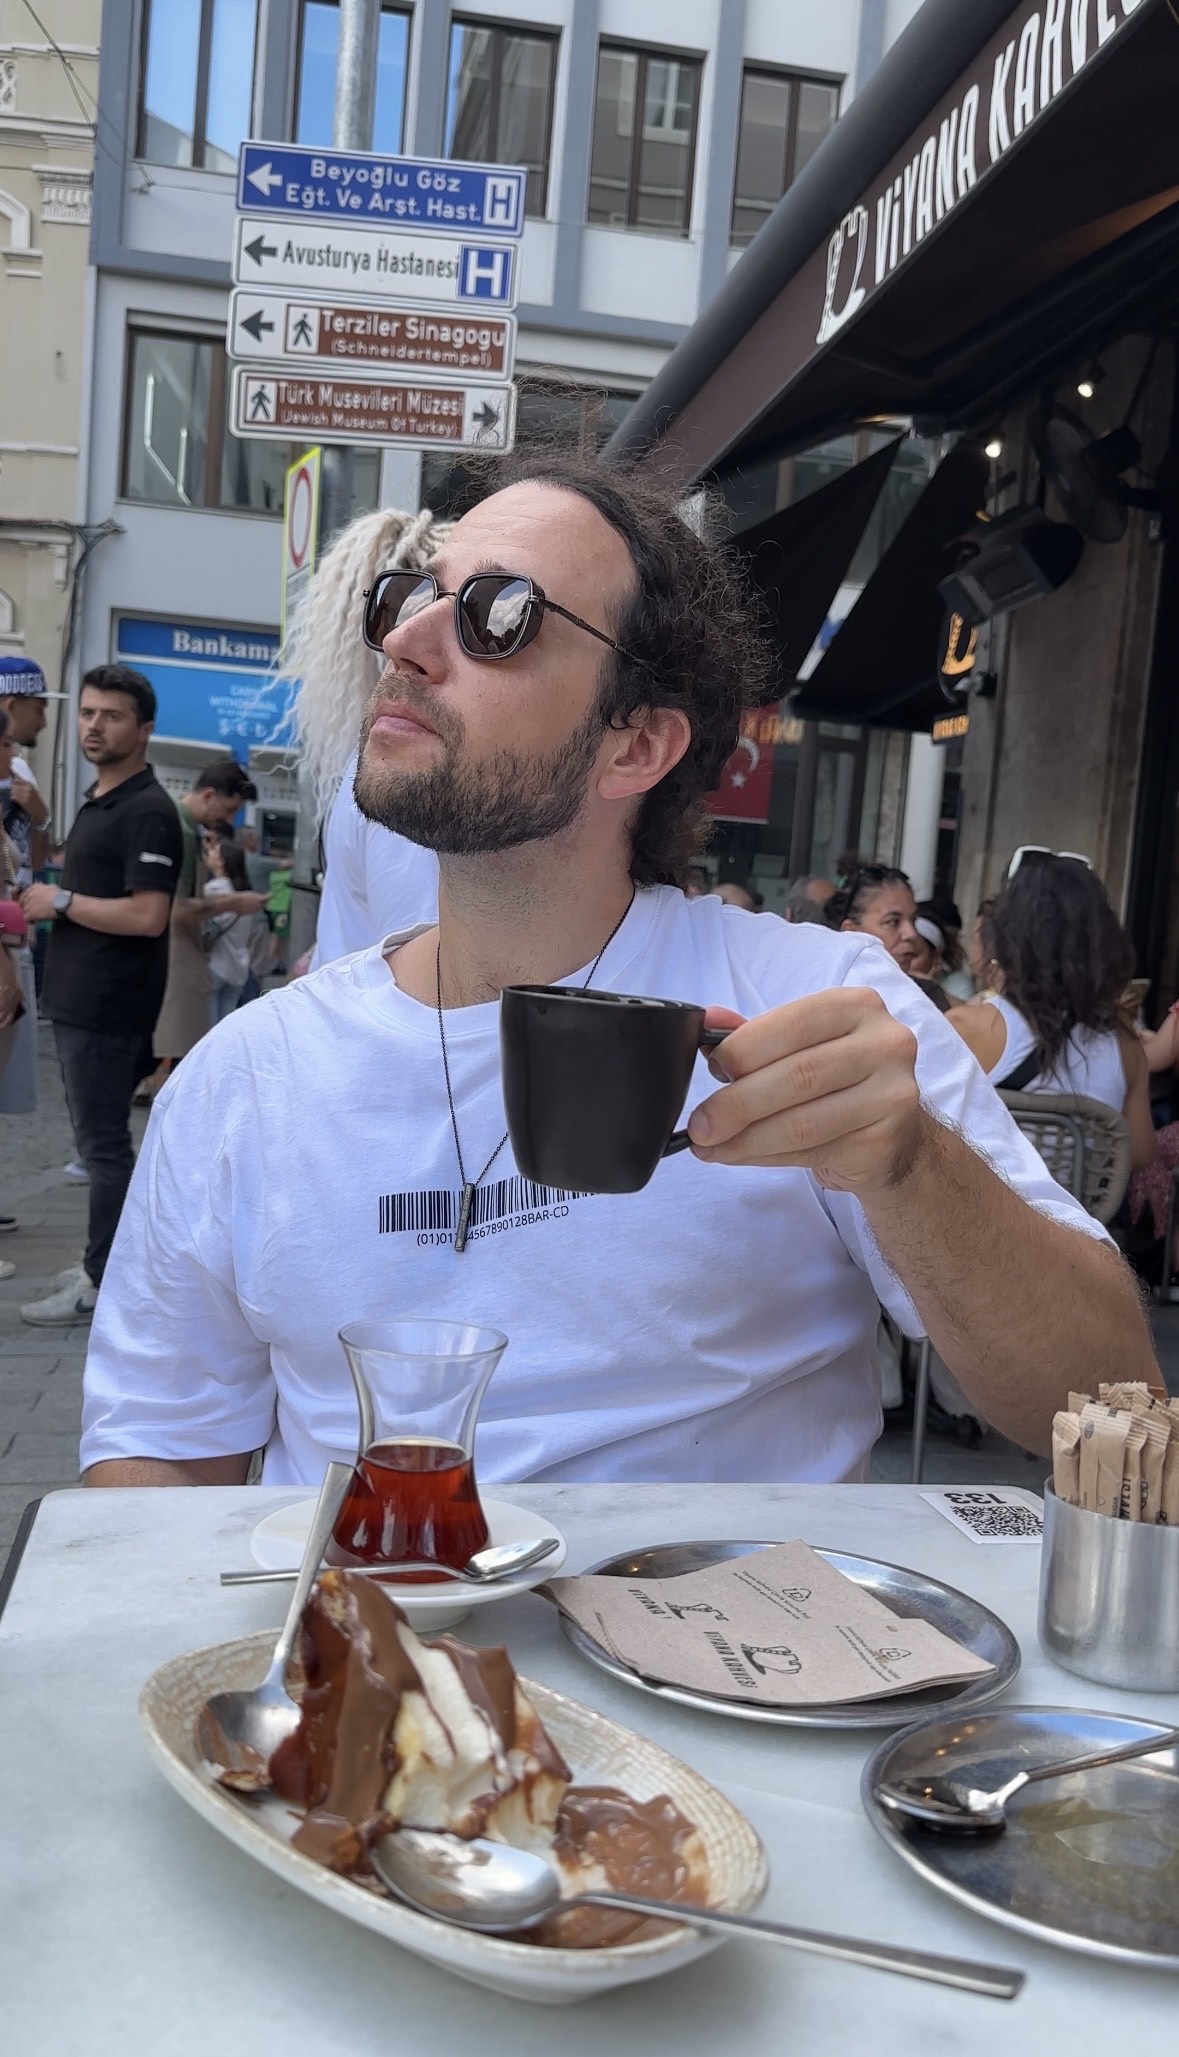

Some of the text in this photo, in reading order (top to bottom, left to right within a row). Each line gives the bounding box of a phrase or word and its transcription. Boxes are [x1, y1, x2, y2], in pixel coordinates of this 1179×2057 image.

[310, 158, 462, 193] Beyoğlu Göz
[285, 182, 331, 209] Eğt.
[335, 187, 363, 209] Ve
[426, 197, 481, 222] Hast.
[282, 240, 460, 280] Avusturya Hastanesi
[322, 309, 506, 351] Terziler Sinagogu
[330, 337, 493, 368] (Schneidertempel)
[278, 381, 464, 417] Türk Musevileri Müzesi
[280, 409, 458, 438] (Jewish Museum Of Turkey)
[943, 1491, 1008, 1505] 133
